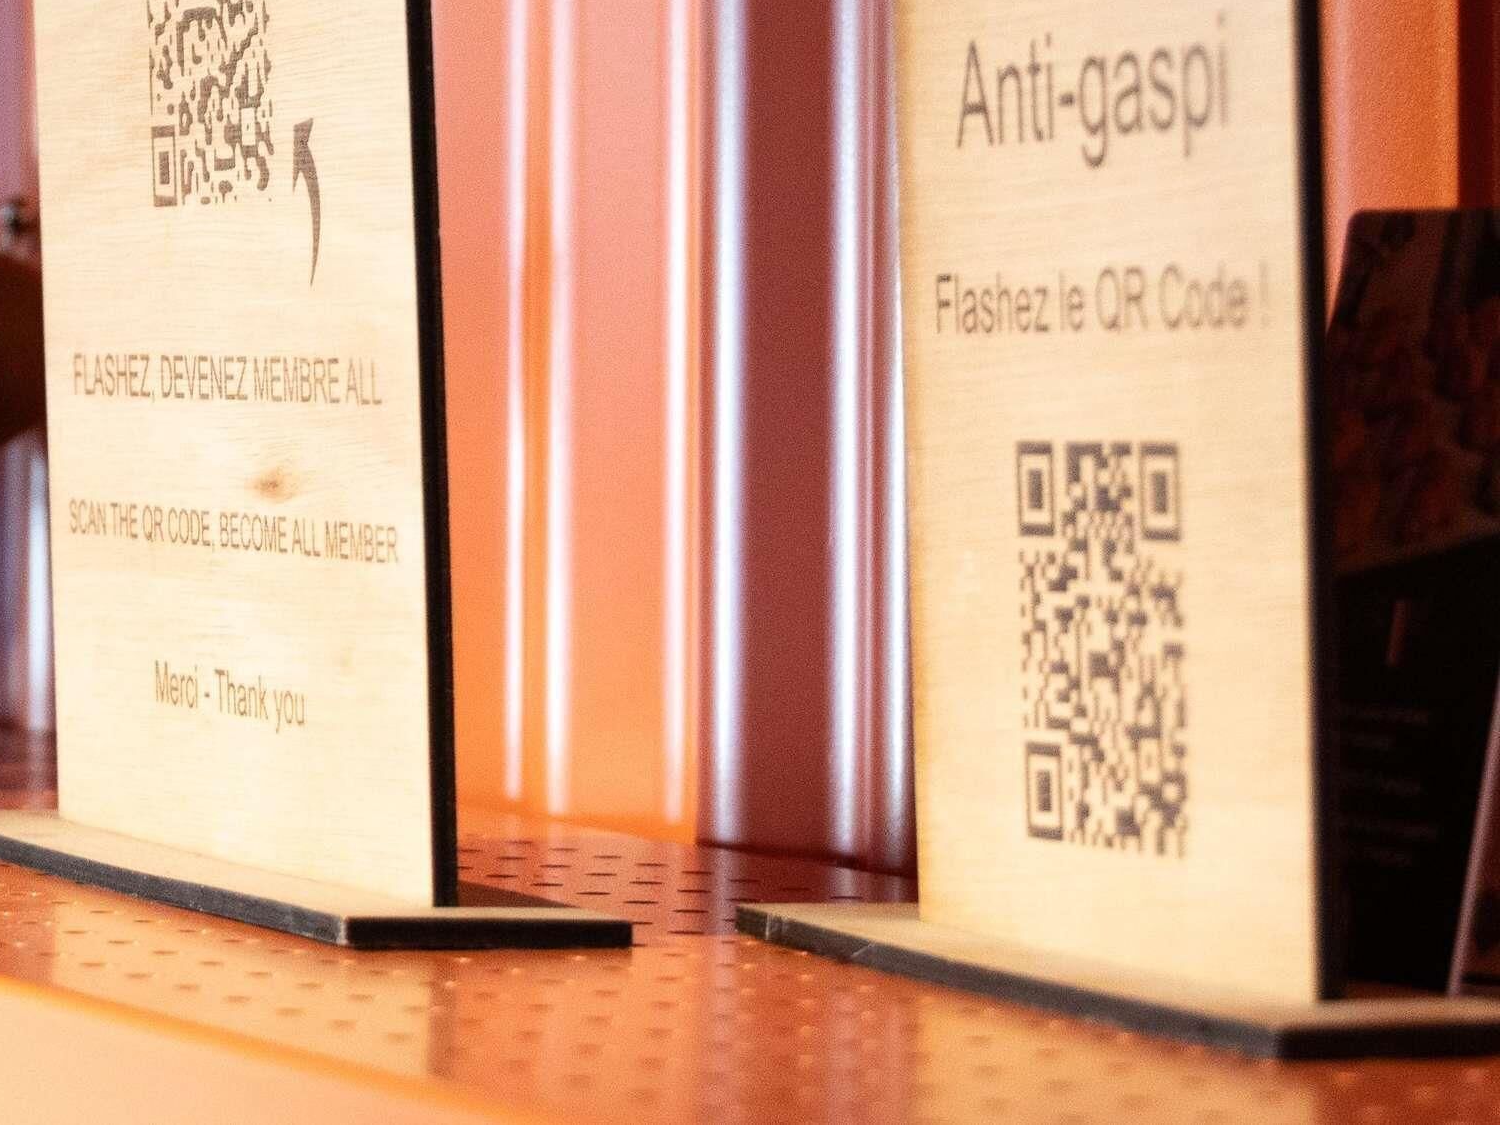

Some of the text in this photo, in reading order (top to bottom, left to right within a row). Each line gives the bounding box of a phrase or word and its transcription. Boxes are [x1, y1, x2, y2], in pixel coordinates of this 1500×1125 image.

[955, 9, 1230, 170] Anti-gaspi
[936, 271, 1050, 335] Flashez
[1059, 270, 1085, 333] le
[1095, 264, 1150, 334] QR
[1158, 261, 1251, 330] Code
[73, 353, 383, 407] FLASHEZ, DEVENEZ MEMBRE ALL
[68, 498, 399, 564] SCAN THE QR CODE, BECOME ALL MEMBER
[155, 659, 199, 710] Merci
[214, 668, 269, 721] Thank
[273, 687, 306, 735] you
